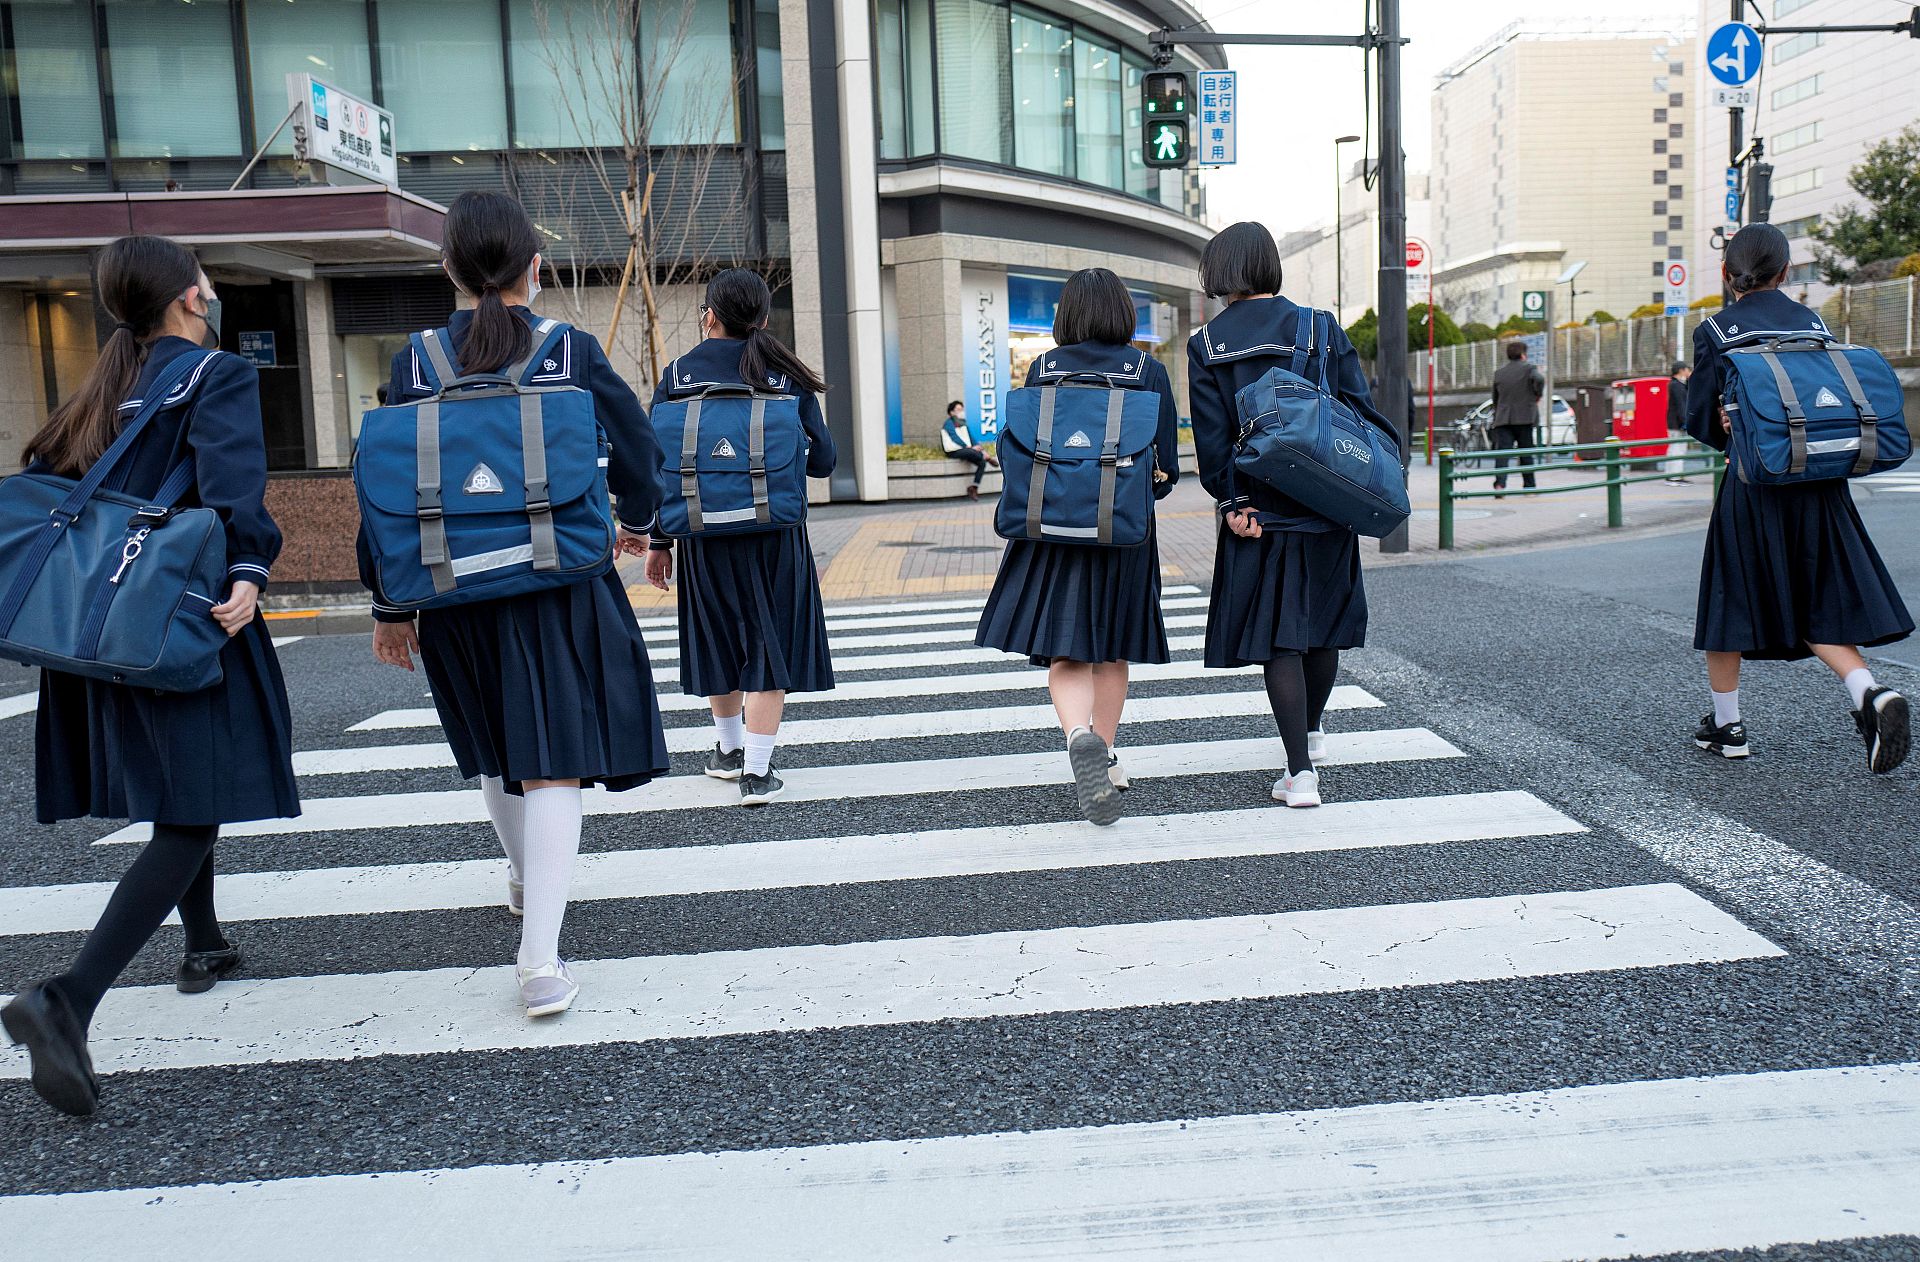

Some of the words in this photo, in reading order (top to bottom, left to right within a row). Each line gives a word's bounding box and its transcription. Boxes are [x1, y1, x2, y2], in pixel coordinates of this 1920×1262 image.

[1203, 78, 1216, 124] 自転車
[1219, 77, 1232, 124] 歩行者
[1211, 128, 1224, 159] 専用
[979, 291, 997, 435] LAWSON
